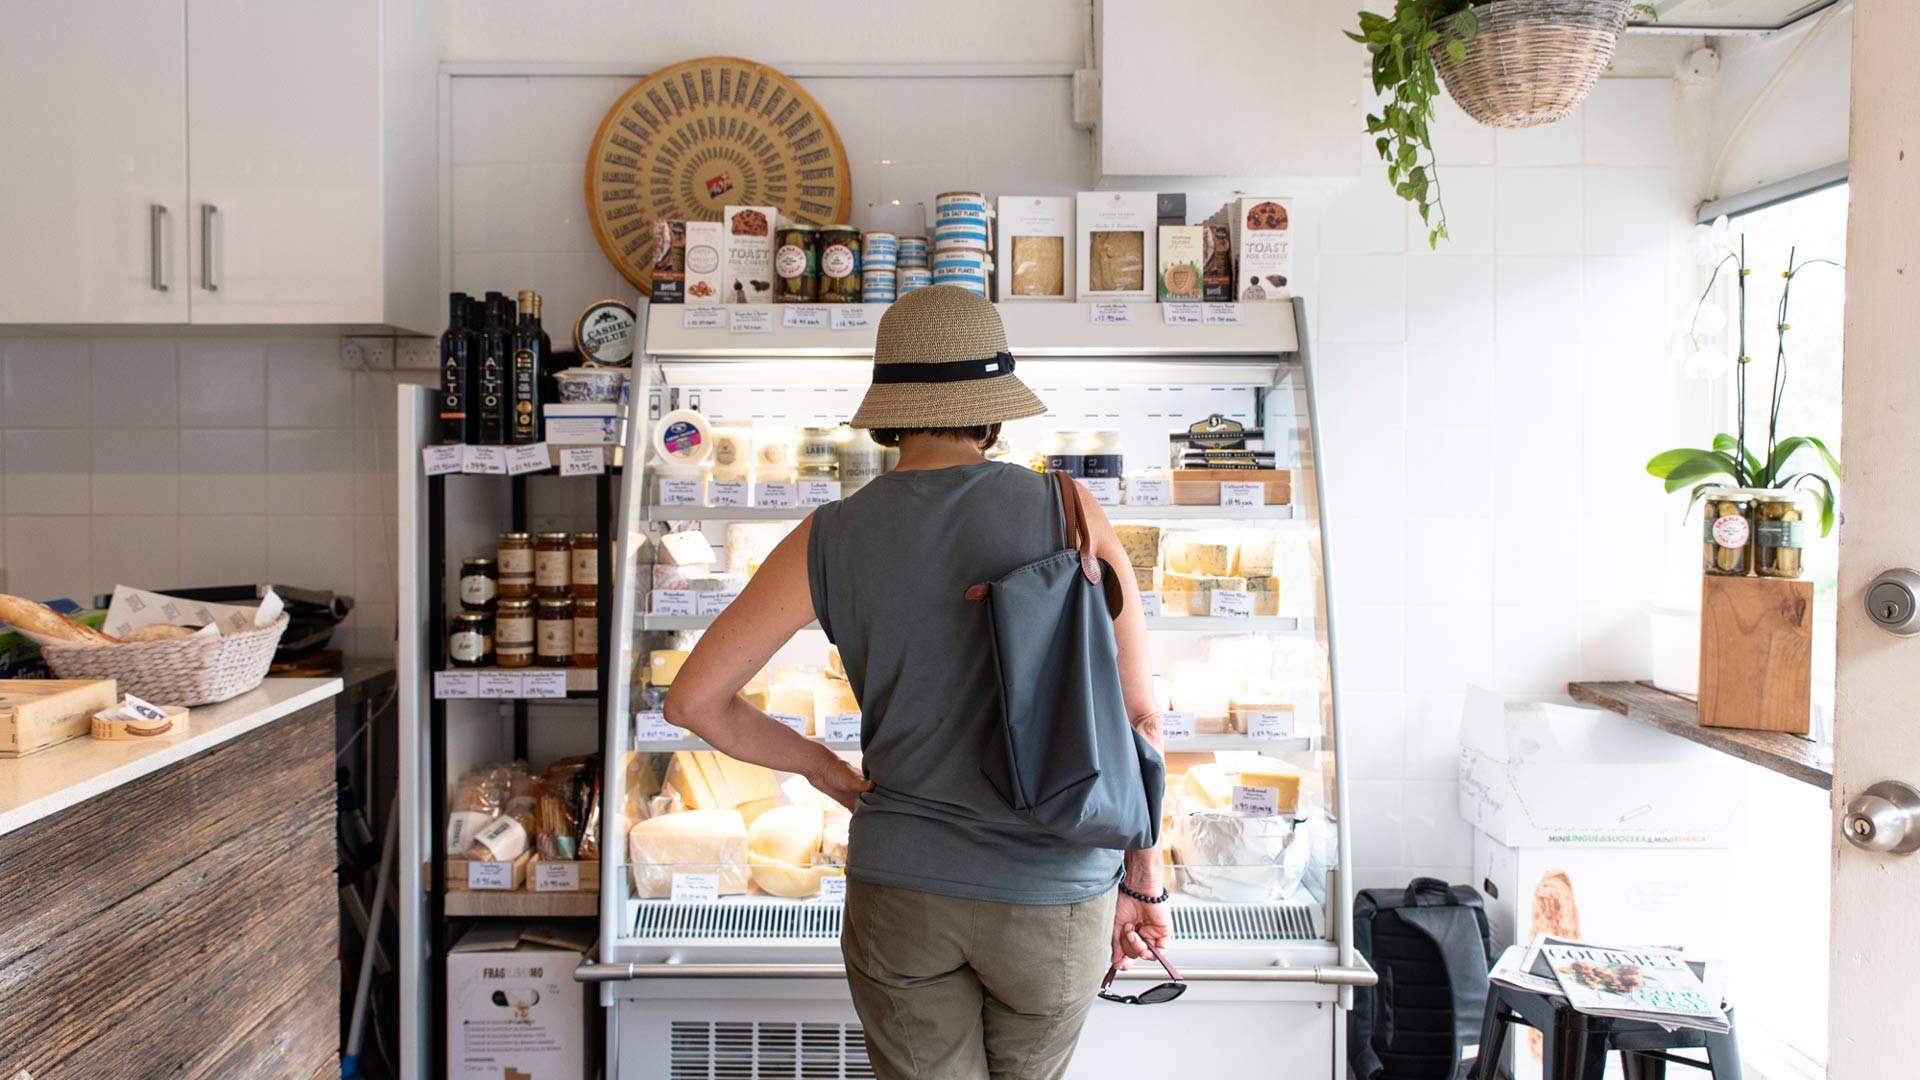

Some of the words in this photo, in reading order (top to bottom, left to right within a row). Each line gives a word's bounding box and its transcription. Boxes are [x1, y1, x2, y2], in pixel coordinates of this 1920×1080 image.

[728, 248, 770, 259] TOAST
[1246, 242, 1288, 253] TOAST
[587, 320, 631, 340] CASHEL
[597, 330, 628, 345] BLUE
[447, 357, 457, 407] ALTO
[485, 357, 496, 407] ALTO
